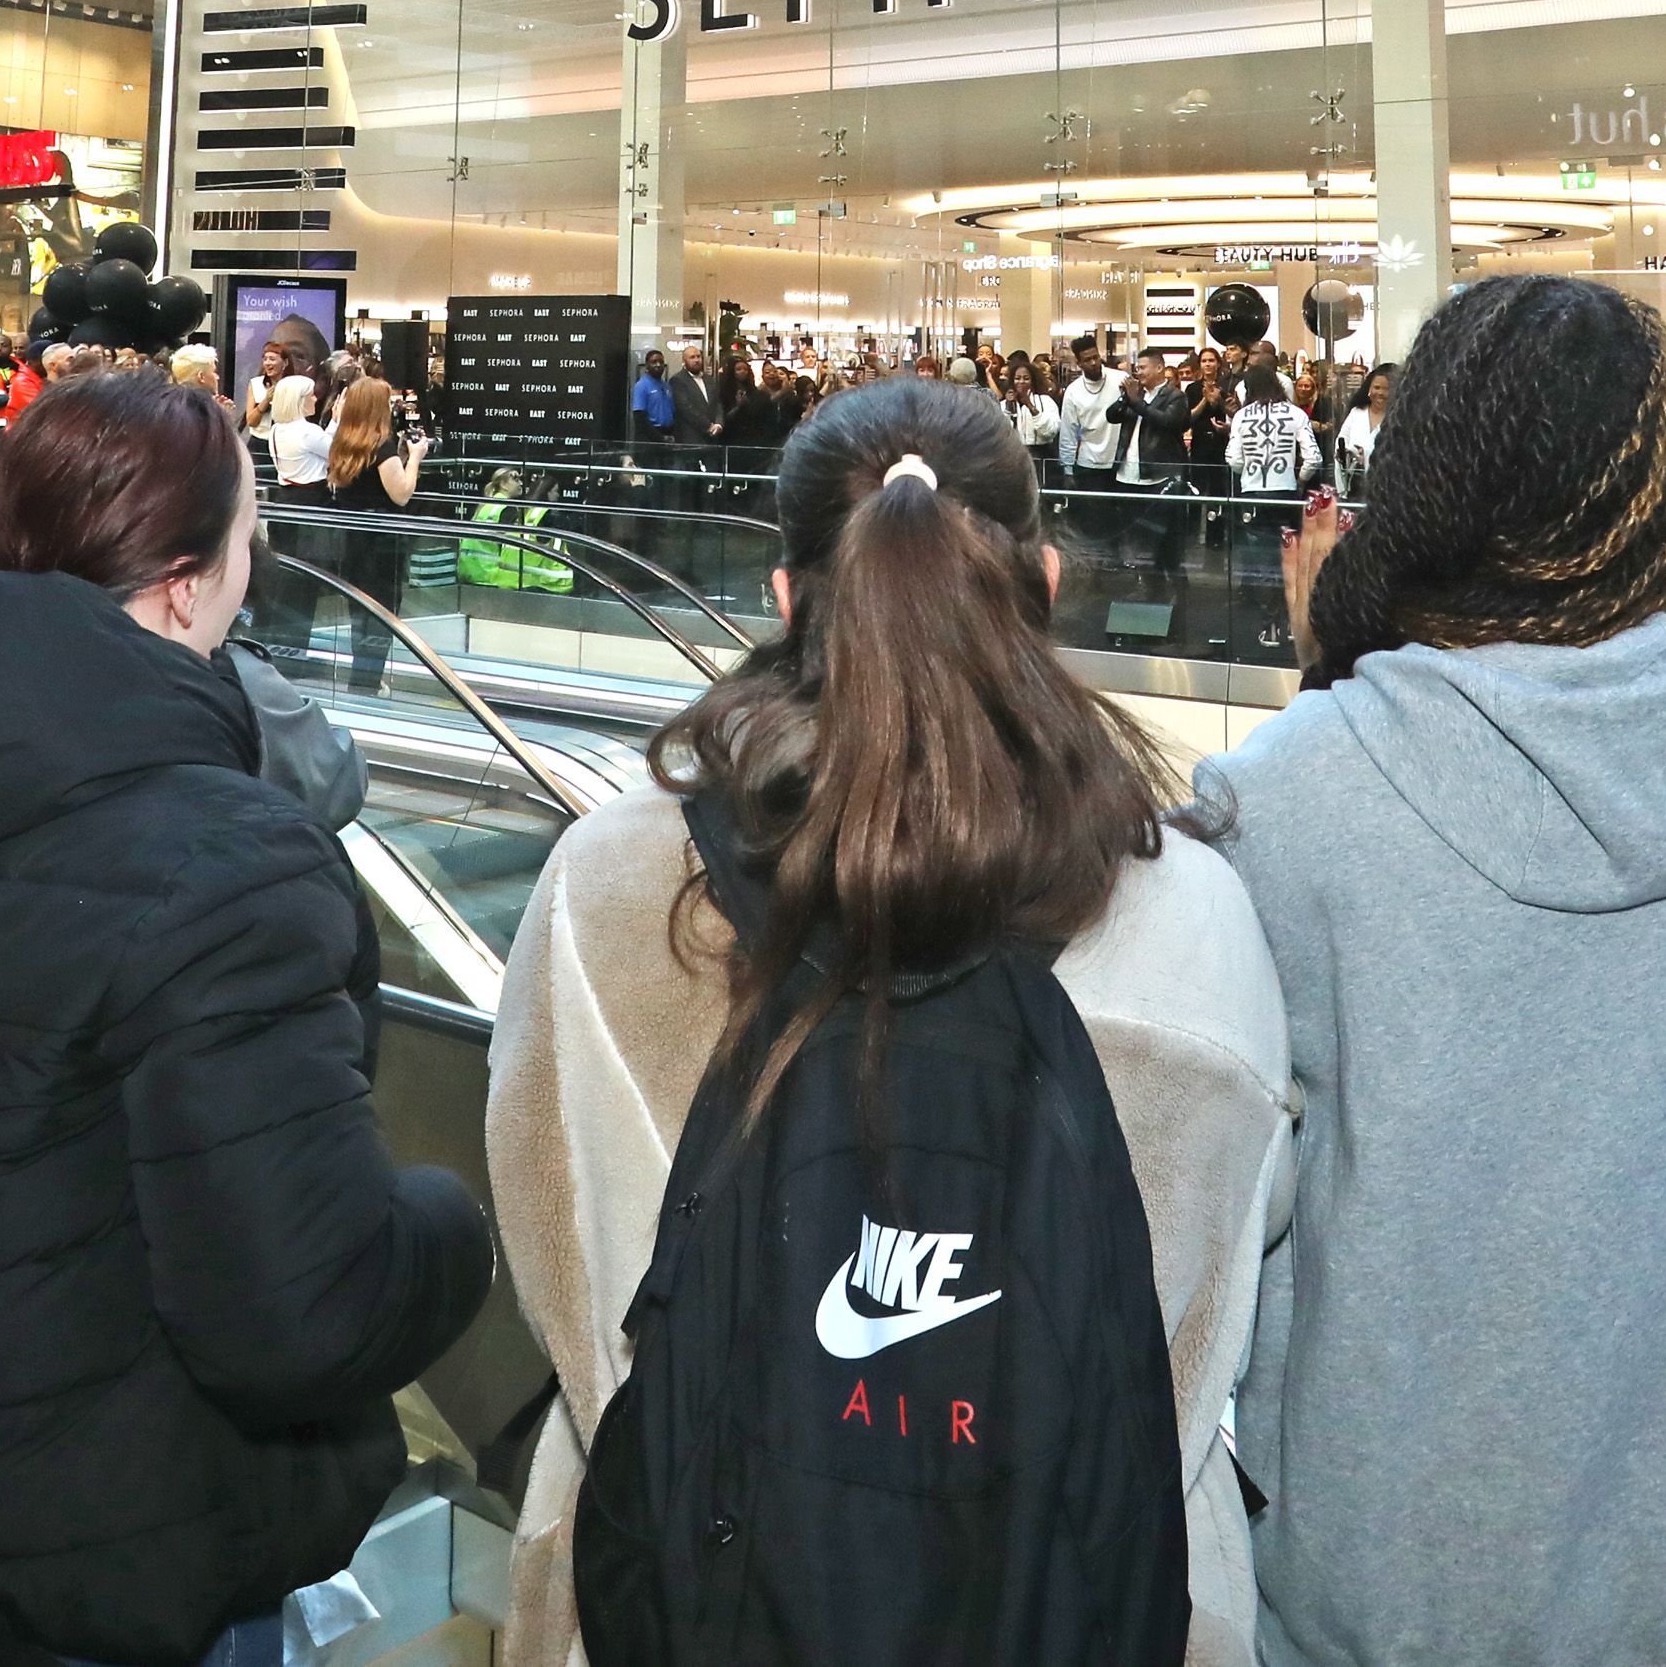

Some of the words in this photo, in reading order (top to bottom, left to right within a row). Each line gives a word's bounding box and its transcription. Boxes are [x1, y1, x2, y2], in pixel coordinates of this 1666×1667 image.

[1214, 245, 1274, 263] BEAUTY
[1281, 247, 1318, 262] HUB
[243, 294, 270, 307] Your
[272, 294, 298, 308] wish
[463, 309, 478, 317] EAST
[489, 308, 524, 317] SEPHORA
[534, 308, 550, 317] EAST
[562, 308, 598, 317] SEPHORA
[453, 334, 487, 342] SEPHORA
[524, 334, 559, 342] SEPHORA
[570, 334, 586, 342] EAST
[461, 358, 476, 366] EAST
[487, 359, 521, 367] SEPHORA
[532, 359, 547, 367] EAST
[559, 359, 596, 368] SEPHORA
[451, 383, 485, 391] SEPHORA
[495, 384, 510, 392] EAST
[521, 384, 557, 393] SEPHORA
[568, 385, 584, 394] EAST
[458, 407, 473, 415] EAST
[485, 408, 519, 417] SEPHORA
[529, 410, 545, 418] EAST
[557, 410, 594, 420] SEPHORA
[563, 489, 579, 498] EAST
[850, 1214, 974, 1312] NIKE
[842, 1378, 977, 1445] AIR
